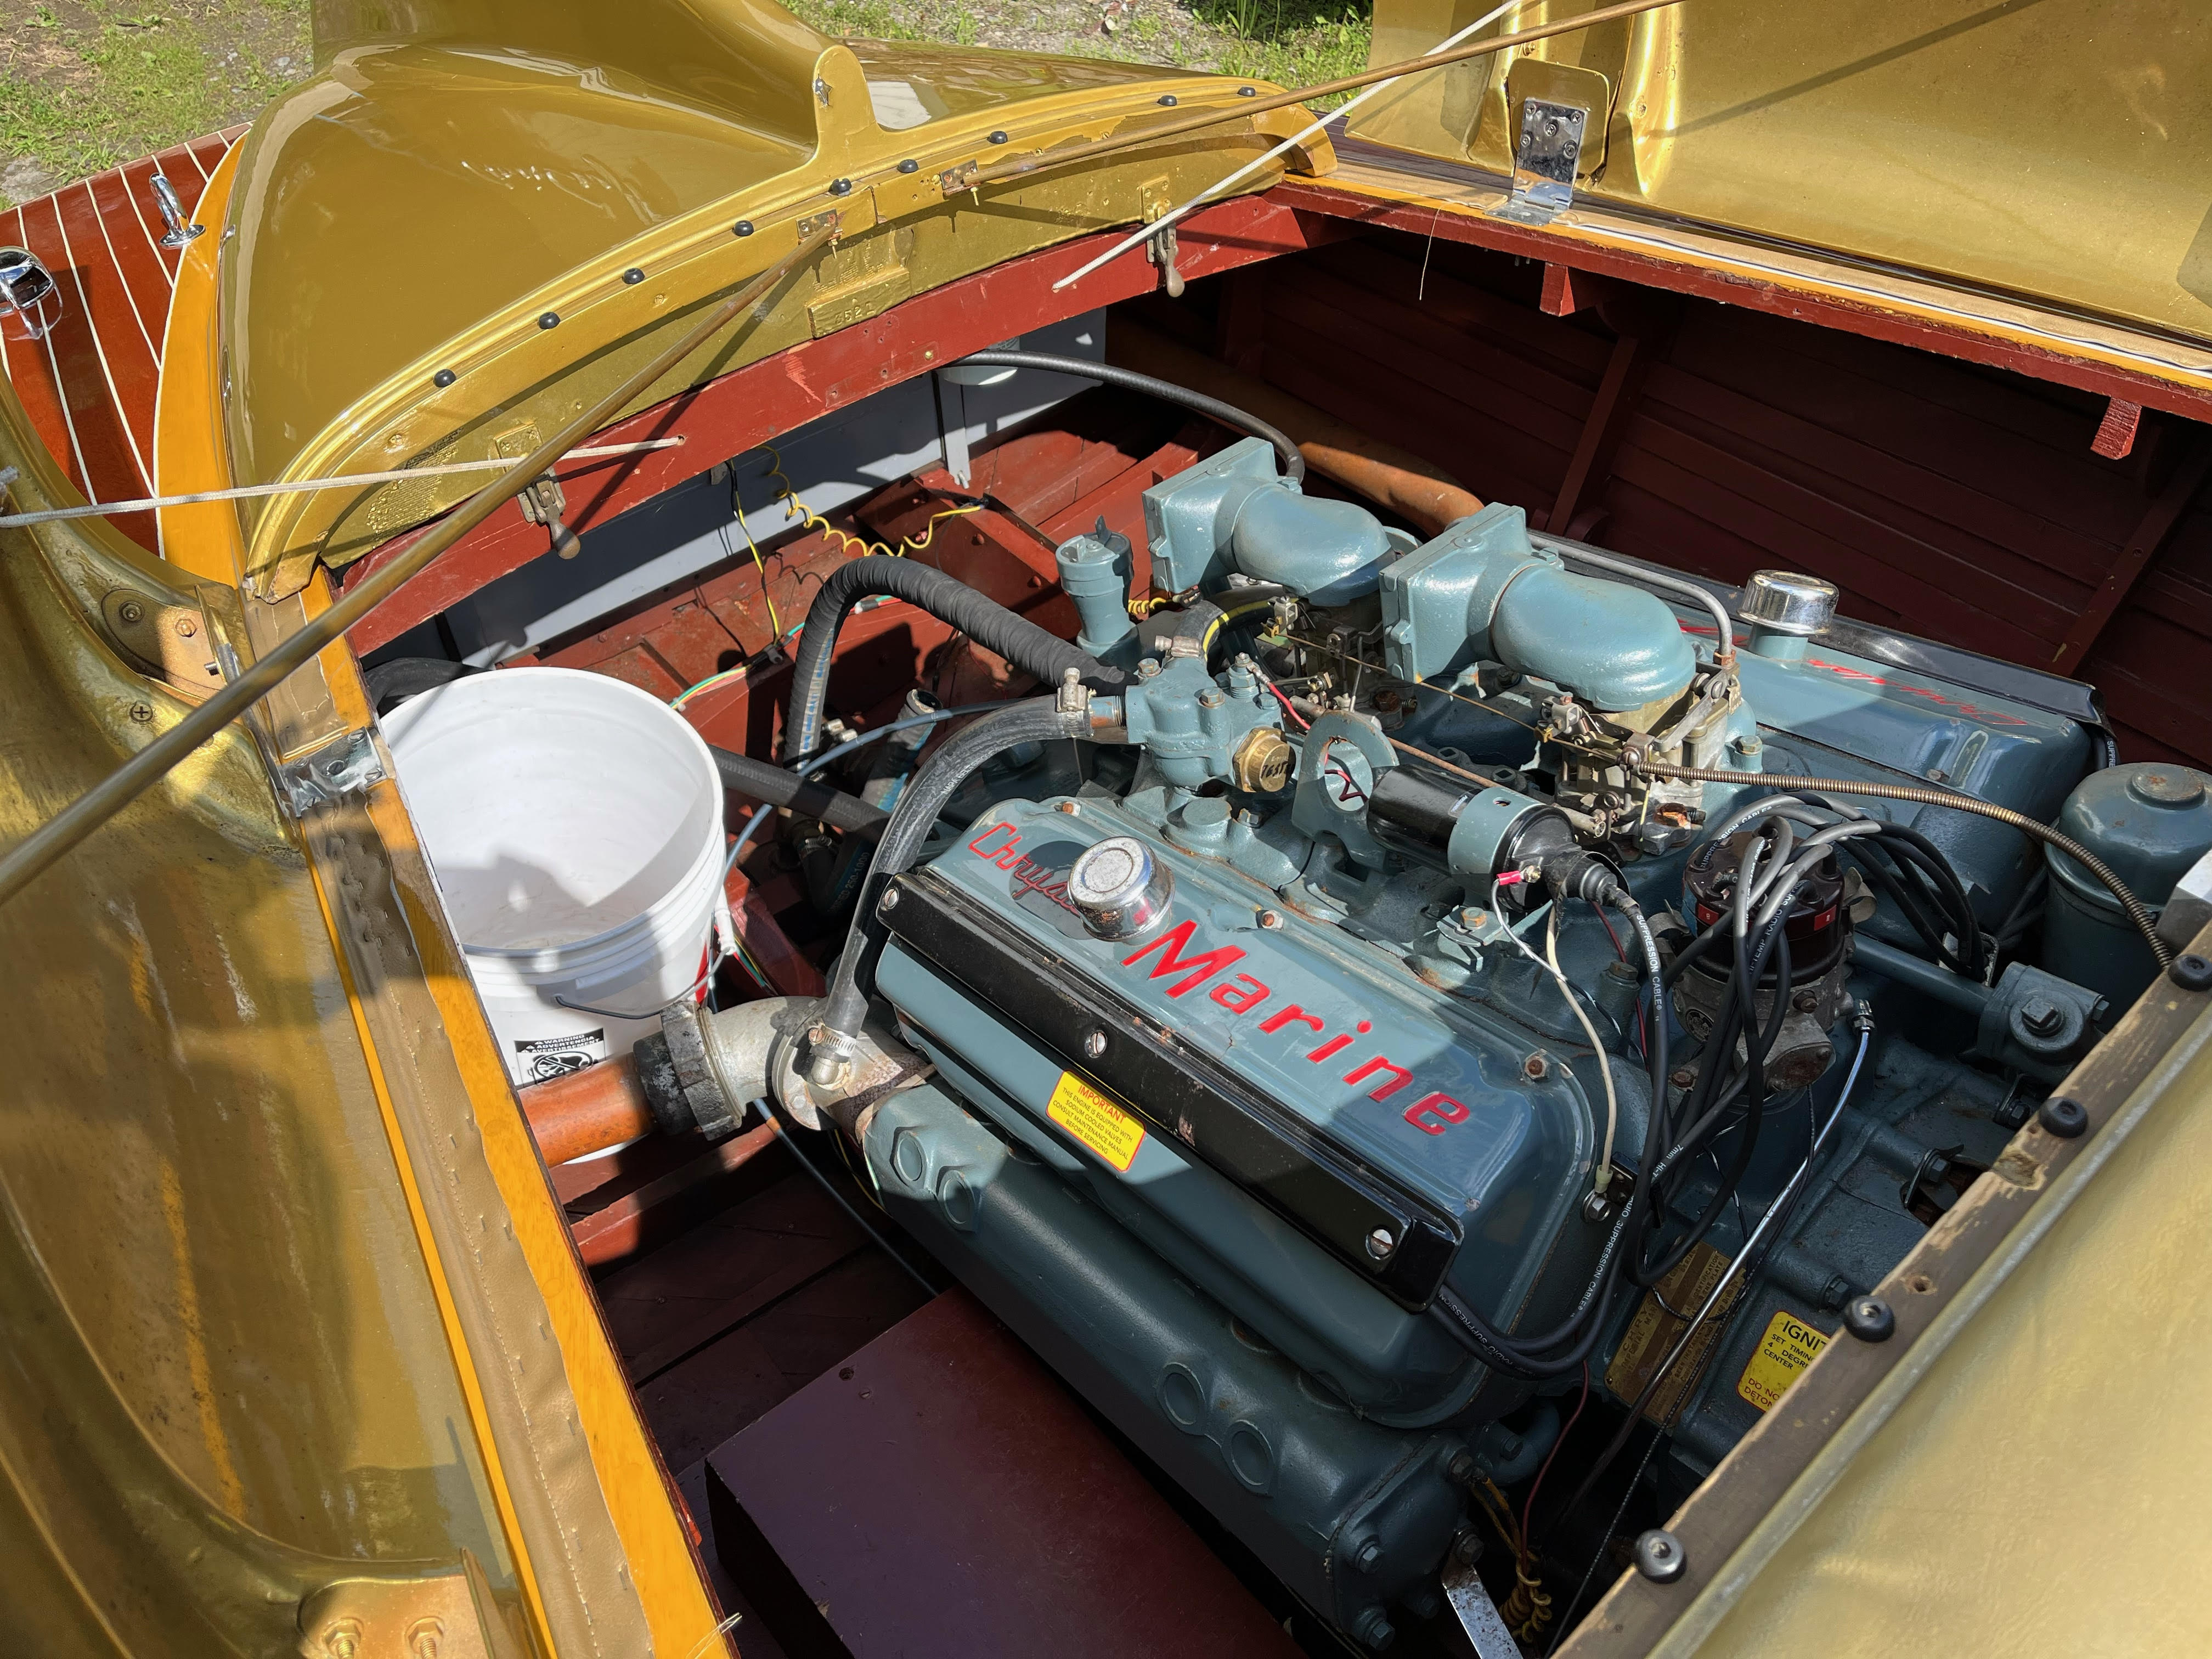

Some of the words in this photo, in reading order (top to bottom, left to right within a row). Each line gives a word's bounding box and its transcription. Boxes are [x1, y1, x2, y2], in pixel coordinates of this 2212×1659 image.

[1637, 915, 1659, 972] SUPPRESSION
[531, 1038, 600, 1053] AVERTISSEMENT
[536, 1036, 595, 1049] ADVERTENCIA
[544, 1034, 585, 1044] WARNING
[1120, 919, 1471, 1136] Marine
[1063, 1087, 1073, 1098] THIS
[1073, 1096, 1091, 1112] ENGINE
[1096, 1112, 1120, 1132] EQUIPPED
[1120, 1130, 1133, 1142] WITH
[1065, 1099, 1085, 1116] SODIUM
[1085, 1114, 1104, 1131] COOLED
[1105, 1128, 1122, 1144] VALVES
[1078, 1085, 1126, 1124] IMPORTANT
[1053, 1100, 1074, 1118] CONSULT
[1073, 1115, 1110, 1144] MAINTENANCE
[1108, 1141, 1128, 1160] MANUAL
[1065, 1119, 1084, 1136] BEFORE
[1084, 1132, 1108, 1154] SERVICING
[1666, 1144, 1684, 1159] 7mm
[1593, 1220, 1623, 1278] SUPPRESSION
[1439, 1294, 1487, 1344] SUPPRESSION
[1771, 1334, 1786, 1345] SET
[1764, 1348, 1793, 1370] CENTER
[1748, 1378, 1762, 1390] DO
